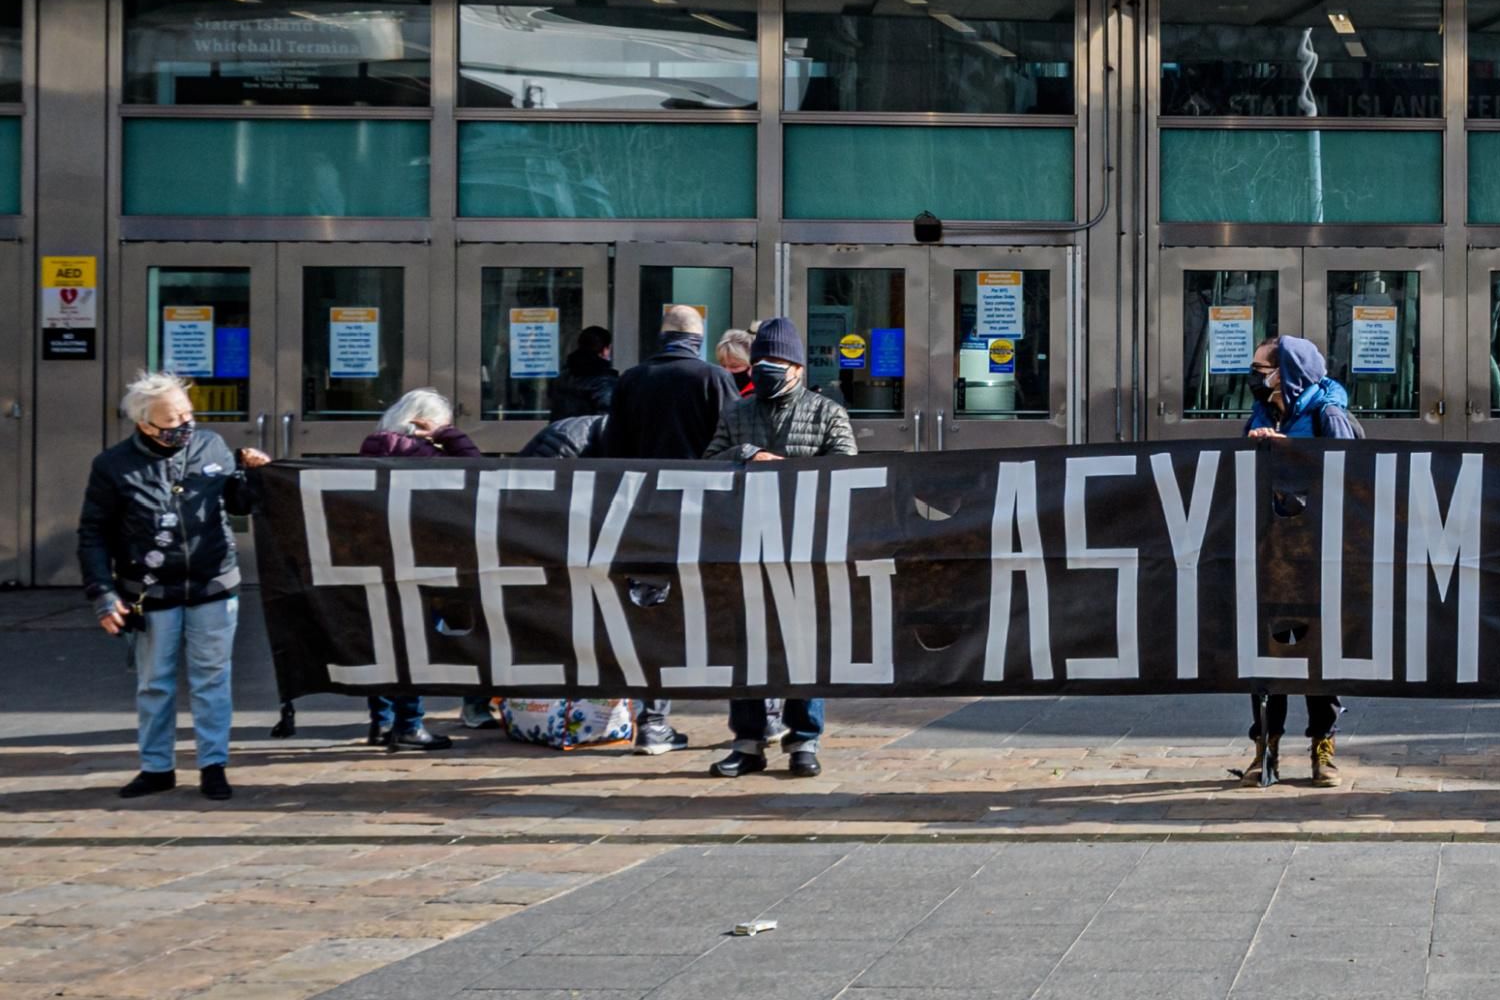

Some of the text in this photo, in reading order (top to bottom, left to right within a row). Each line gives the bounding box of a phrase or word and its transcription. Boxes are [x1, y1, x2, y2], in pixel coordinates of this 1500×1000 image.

[194, 39, 281, 53] Whitehall
[1229, 94, 1328, 116] STATN
[56, 268, 82, 278] AED
[300, 465, 897, 689] SEEKING
[983, 451, 1483, 683] ASYLUM
